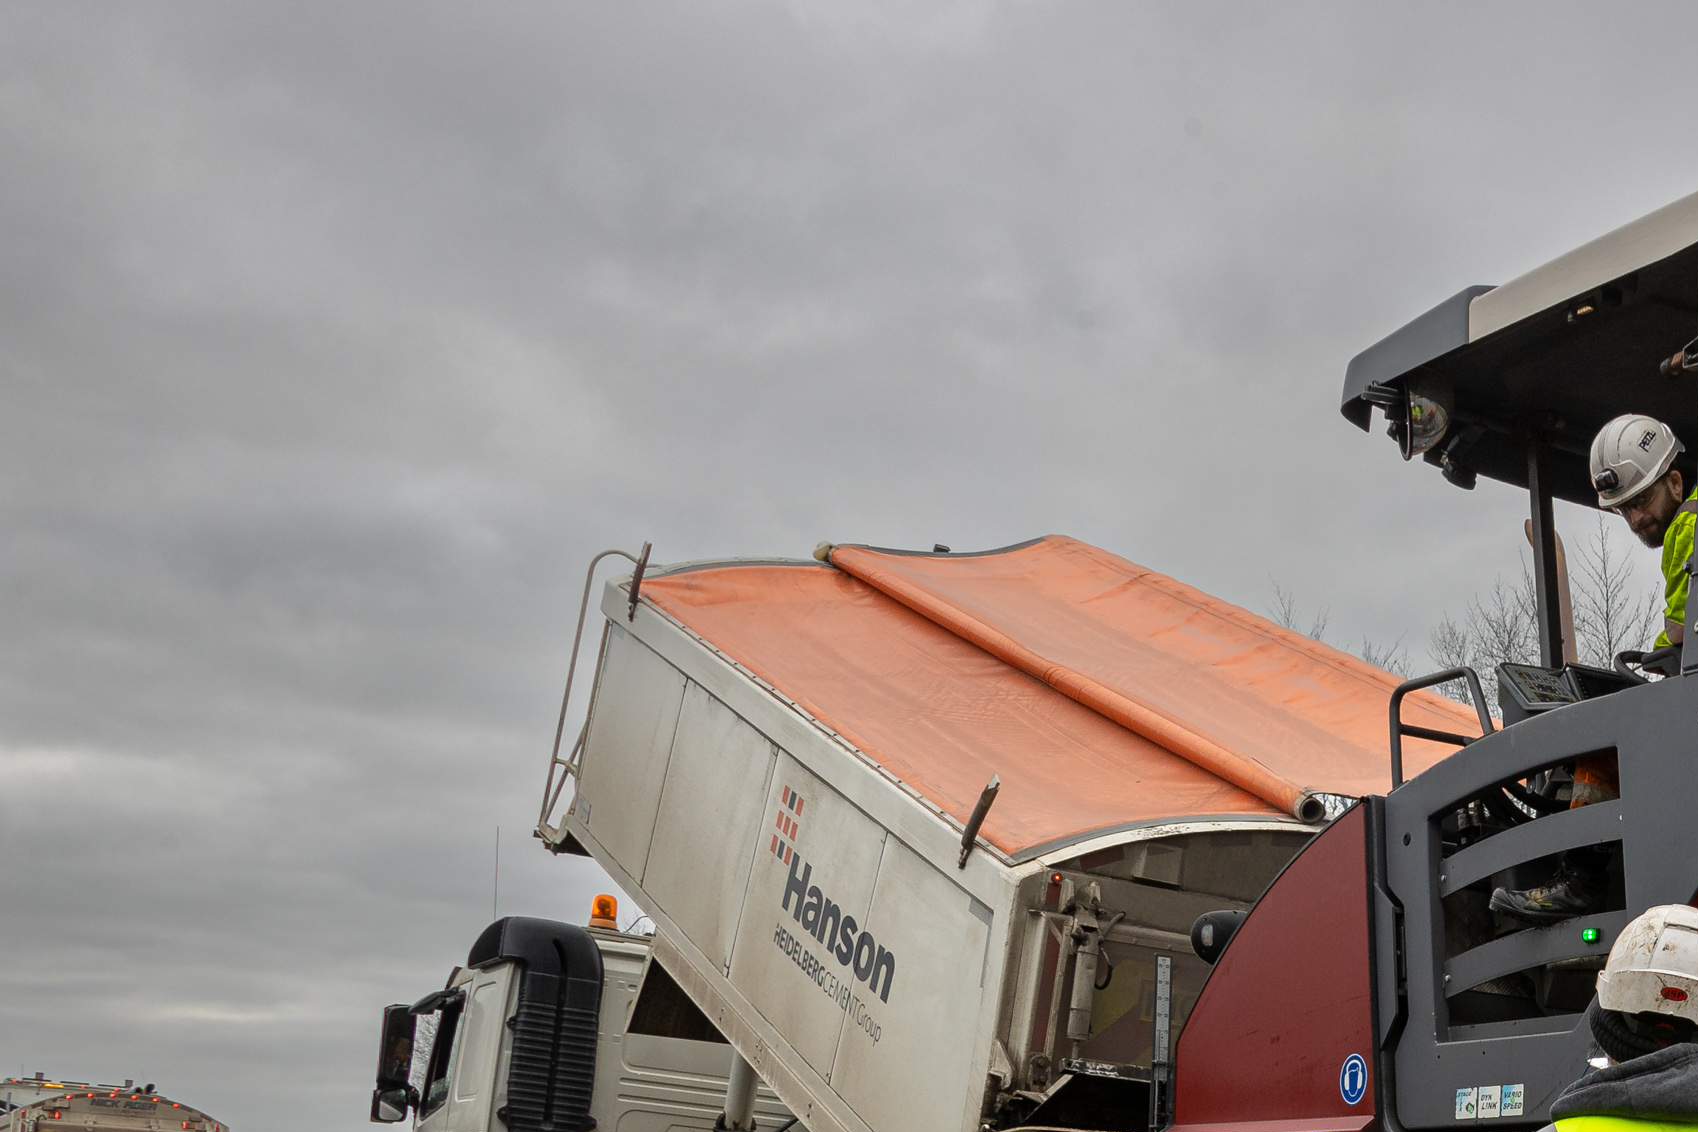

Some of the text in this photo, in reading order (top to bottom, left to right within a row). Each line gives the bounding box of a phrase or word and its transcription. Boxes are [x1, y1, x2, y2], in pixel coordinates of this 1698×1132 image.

[1639, 430, 1657, 453] PETZL
[781, 852, 896, 1004] Hanson
[1481, 1102, 1498, 1110] LINK
[1503, 1102, 1522, 1110] SPEED
